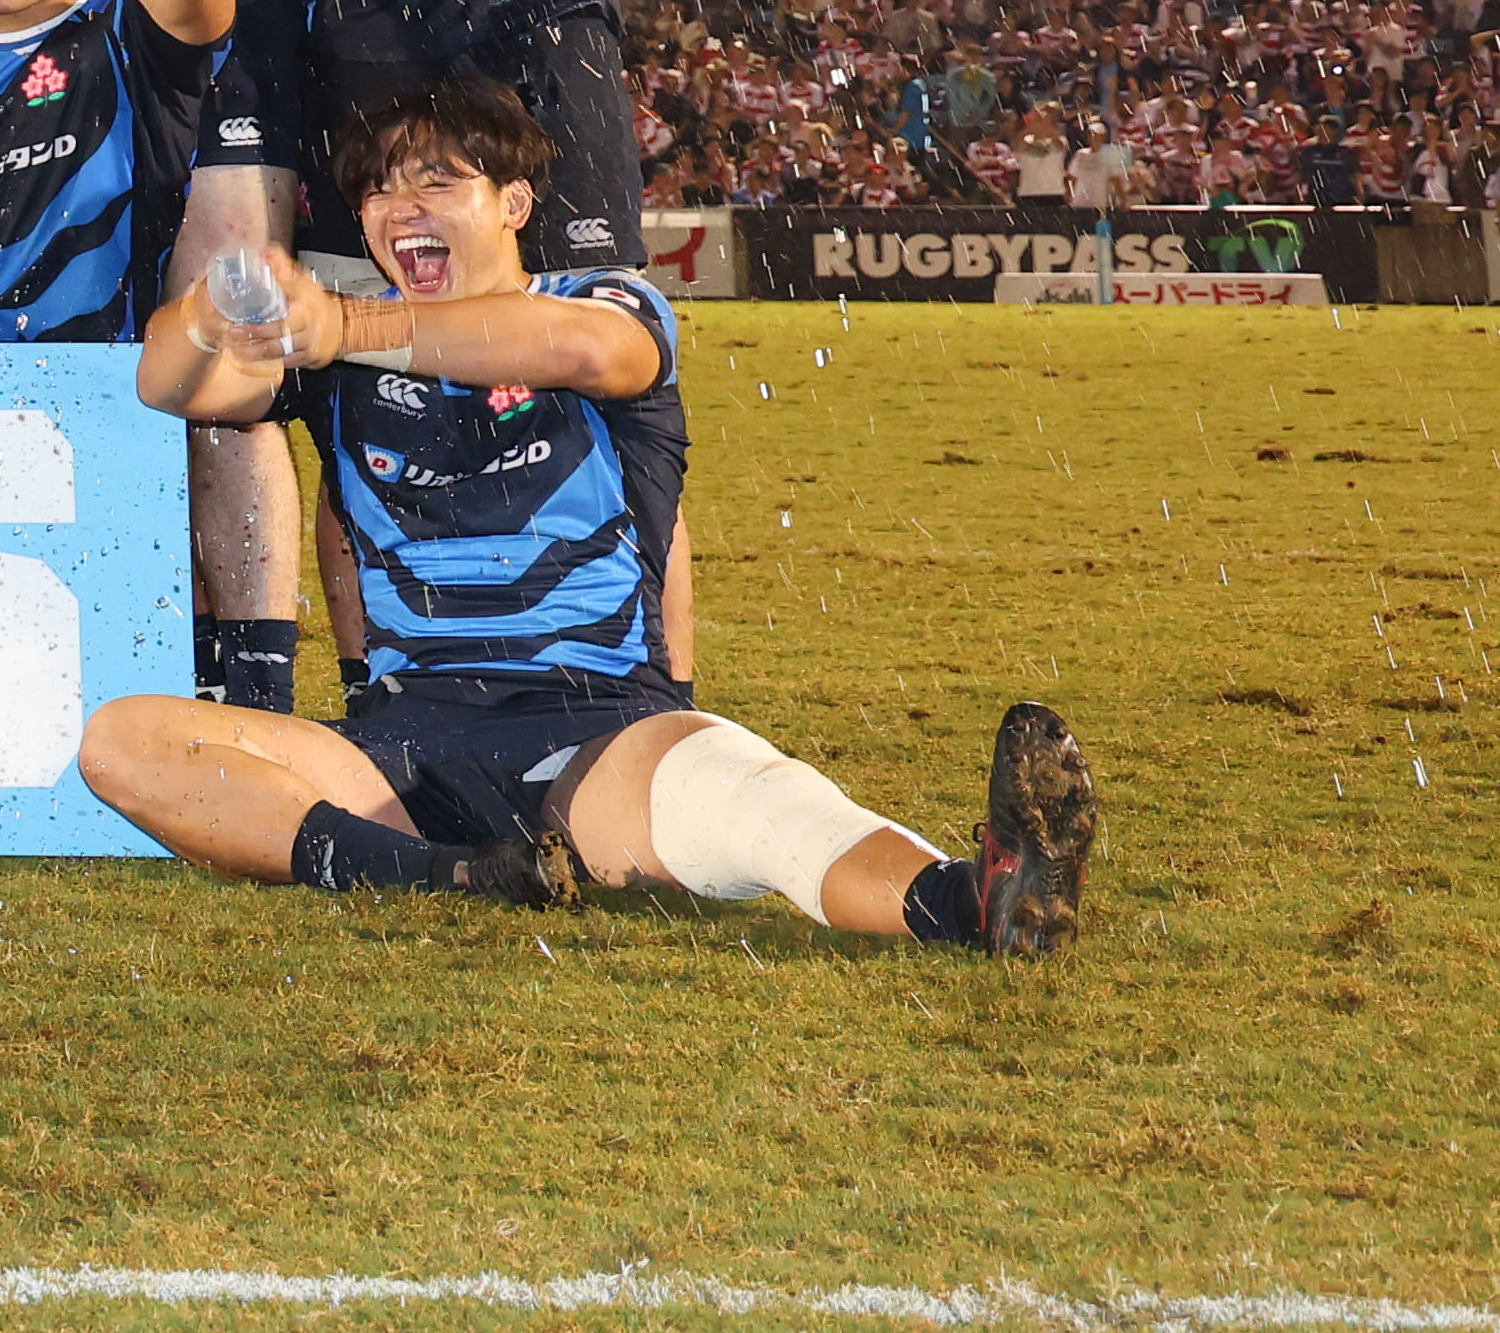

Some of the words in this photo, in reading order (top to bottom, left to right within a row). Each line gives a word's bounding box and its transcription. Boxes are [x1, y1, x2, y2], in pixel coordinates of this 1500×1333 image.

[813, 233, 1191, 278] RUGBYPASS
[1208, 220, 1302, 273] TV
[373, 398, 425, 420] canterbury
